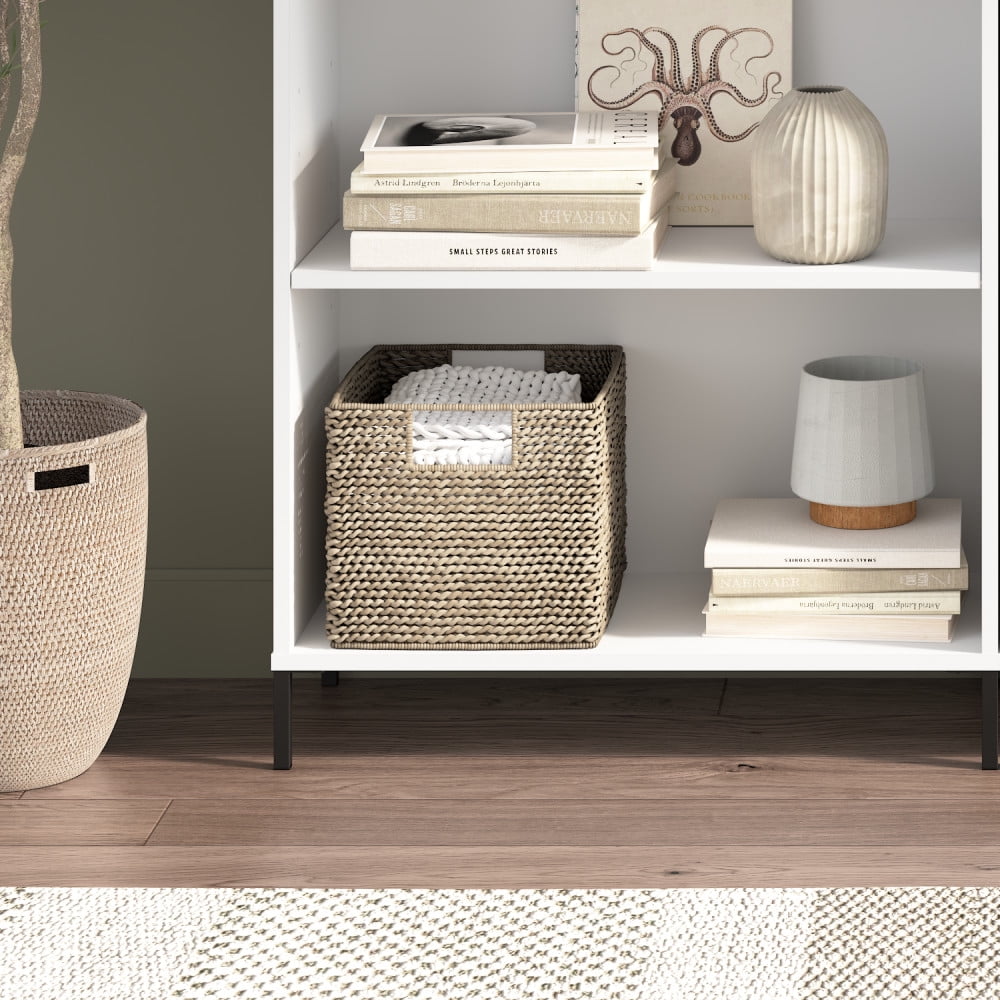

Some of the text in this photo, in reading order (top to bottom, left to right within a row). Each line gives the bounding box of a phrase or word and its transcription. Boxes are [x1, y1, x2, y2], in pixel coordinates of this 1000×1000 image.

[374, 179, 399, 187] Astrid
[402, 179, 441, 189] Lindgren
[452, 179, 490, 187] Bröderna
[884, 601, 916, 610] Lindgren
